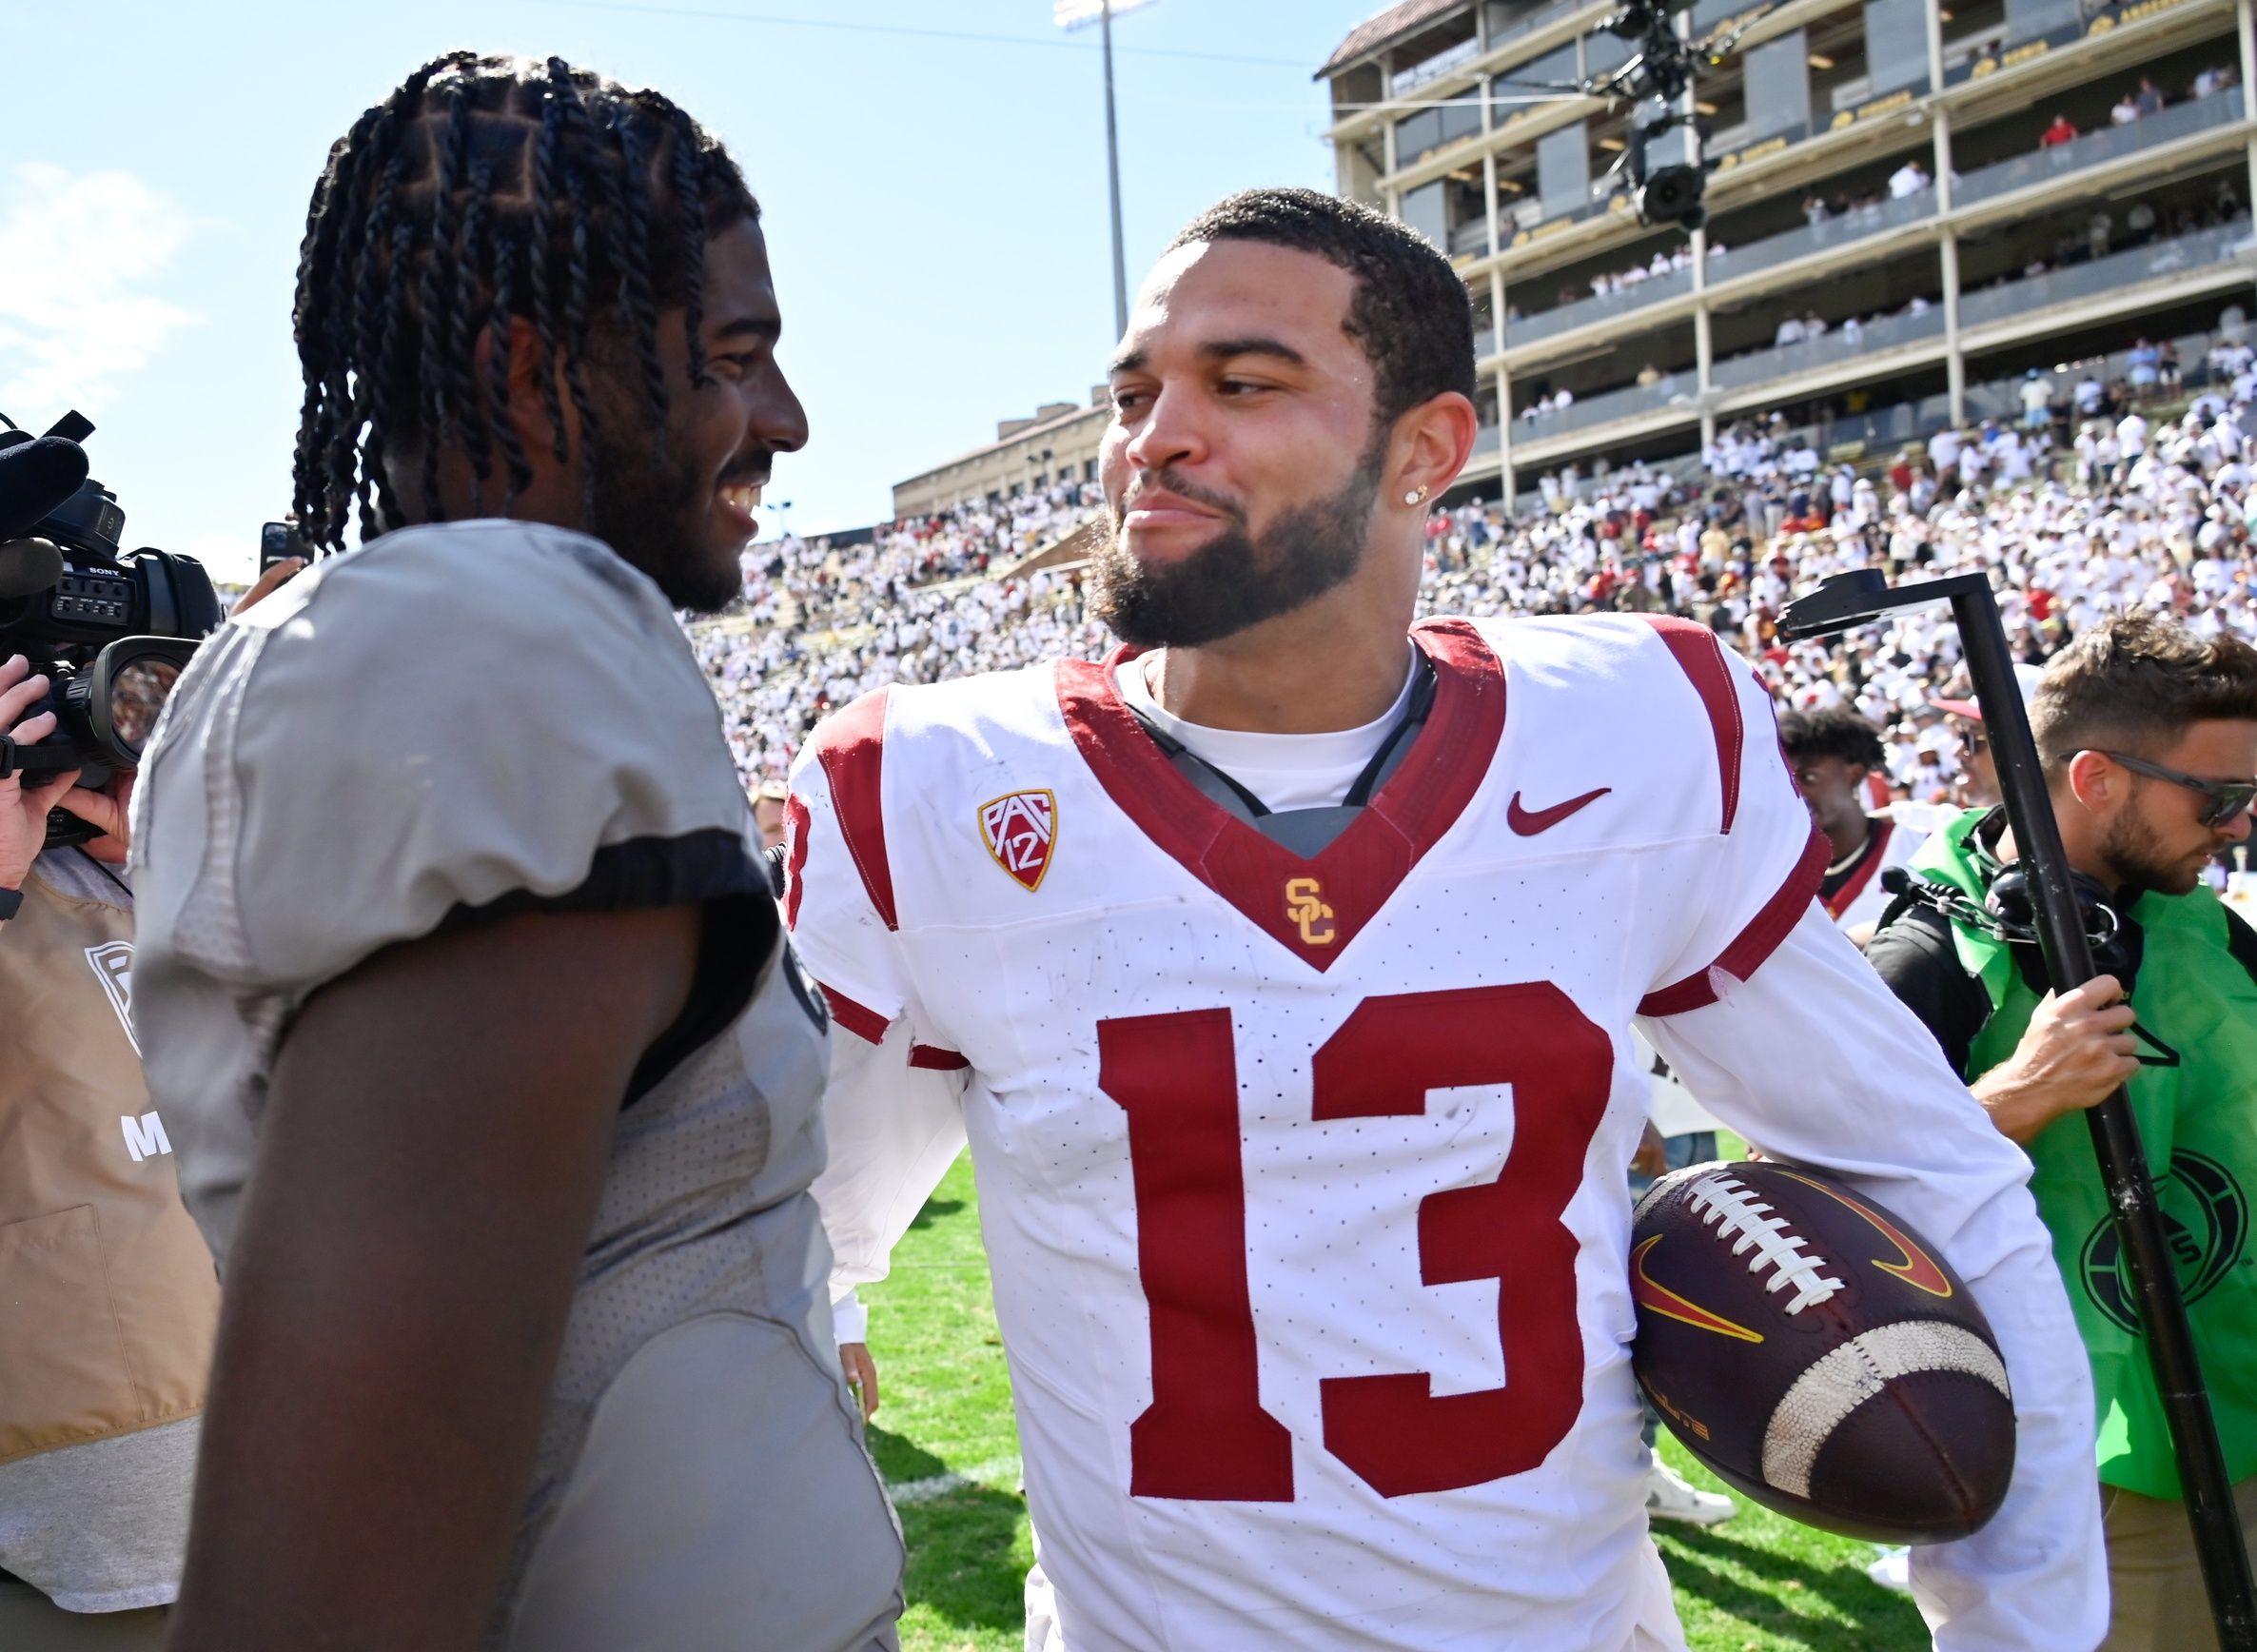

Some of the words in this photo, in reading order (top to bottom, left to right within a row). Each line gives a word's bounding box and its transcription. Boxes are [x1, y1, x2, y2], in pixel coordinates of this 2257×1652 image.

[88, 567, 120, 576] SONY
[982, 794, 1051, 857] PAC
[1005, 832, 1043, 872] 12
[1286, 877, 1335, 945] SC
[1097, 980, 1615, 1502] 13
